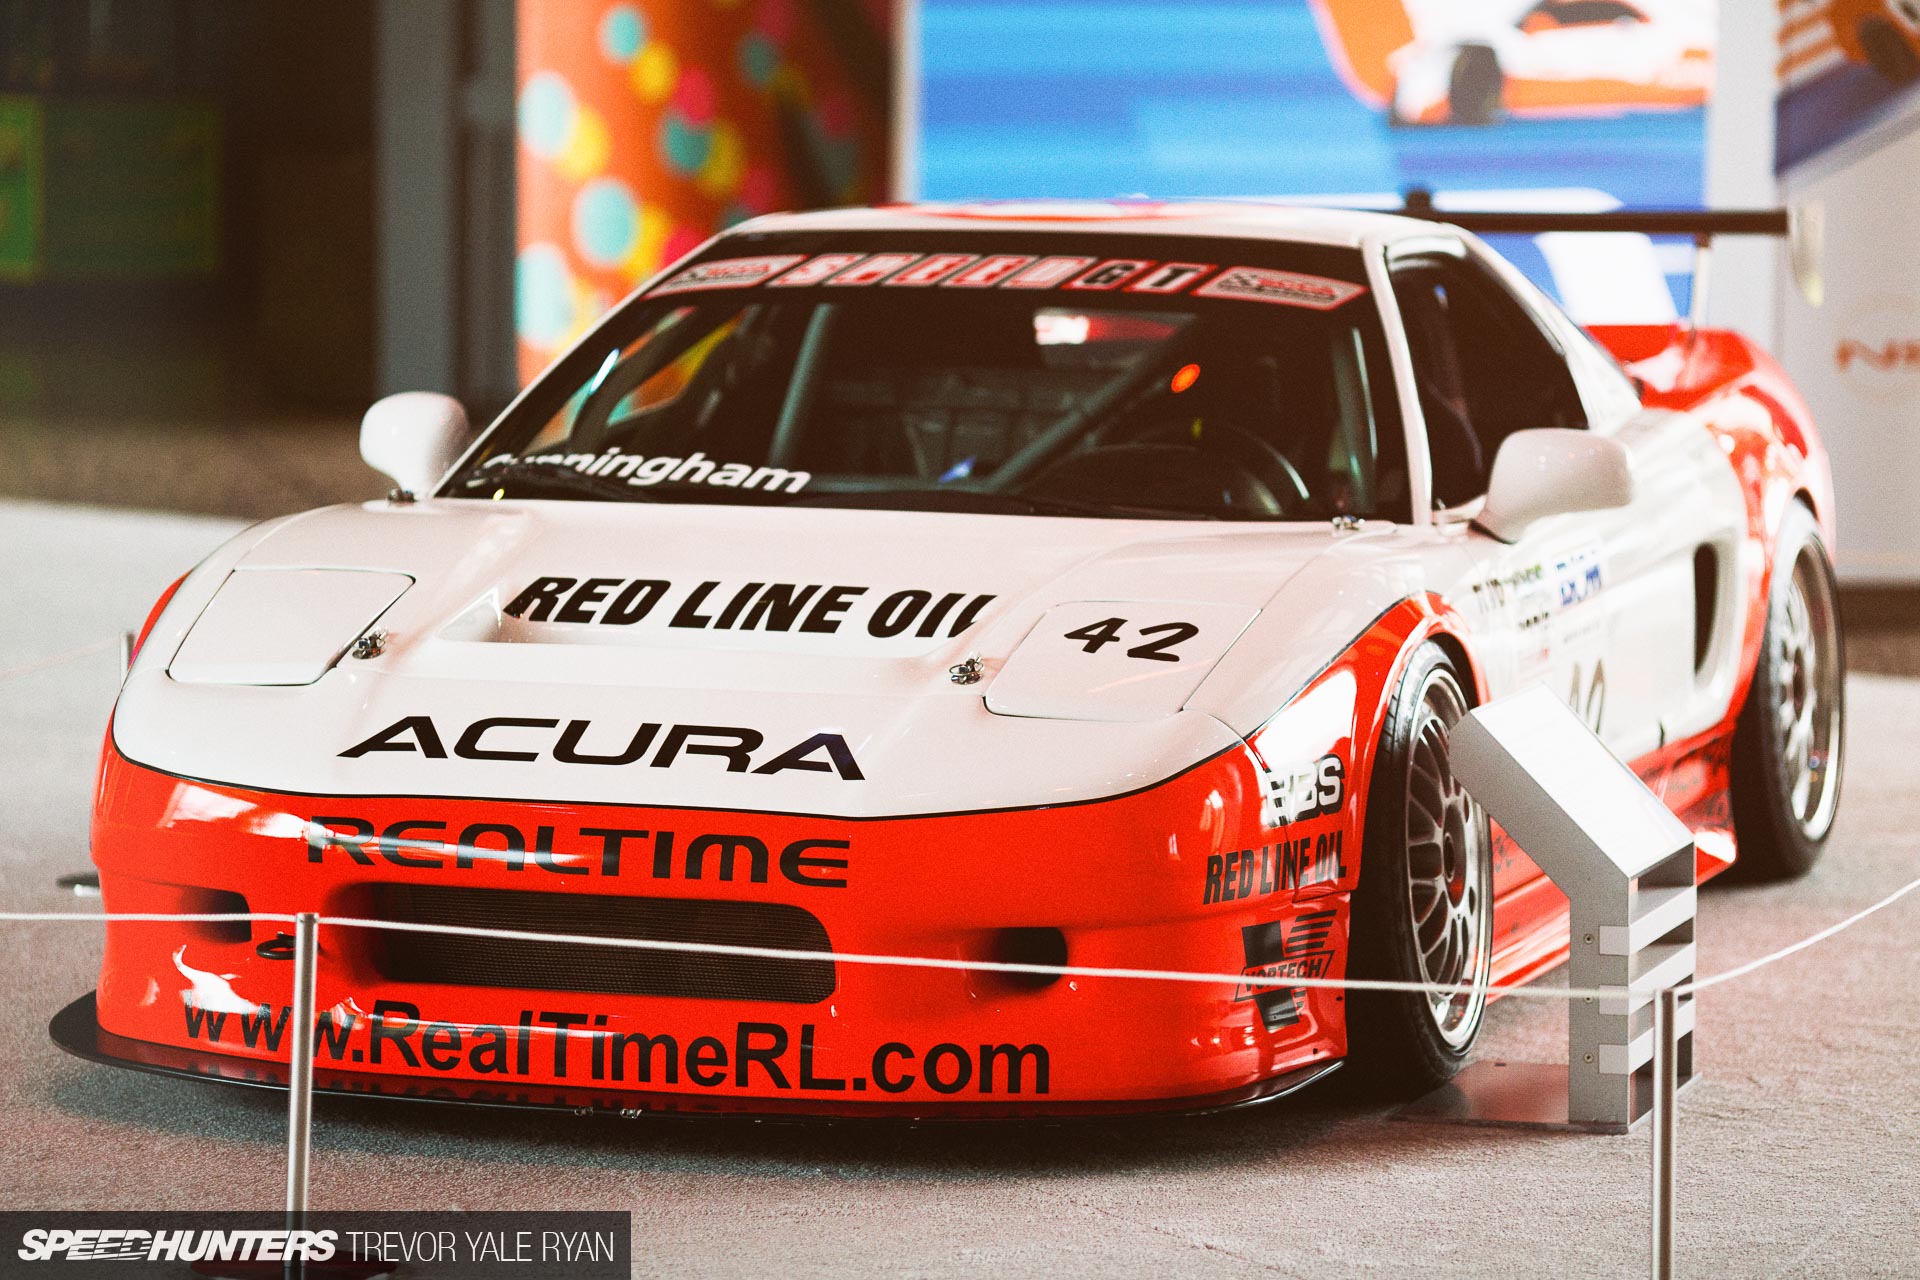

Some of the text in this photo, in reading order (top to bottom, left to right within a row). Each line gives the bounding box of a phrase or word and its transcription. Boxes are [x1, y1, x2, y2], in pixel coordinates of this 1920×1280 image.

[503, 576, 998, 639] RED LINE OIL
[1064, 617, 1199, 662] 42
[336, 716, 866, 781] ACURA
[1266, 753, 1346, 828] BBS
[307, 816, 851, 888] REALTIME
[1203, 830, 1347, 906] RED LINE OIL
[183, 991, 1050, 1095] www.RealTimeRL.com
